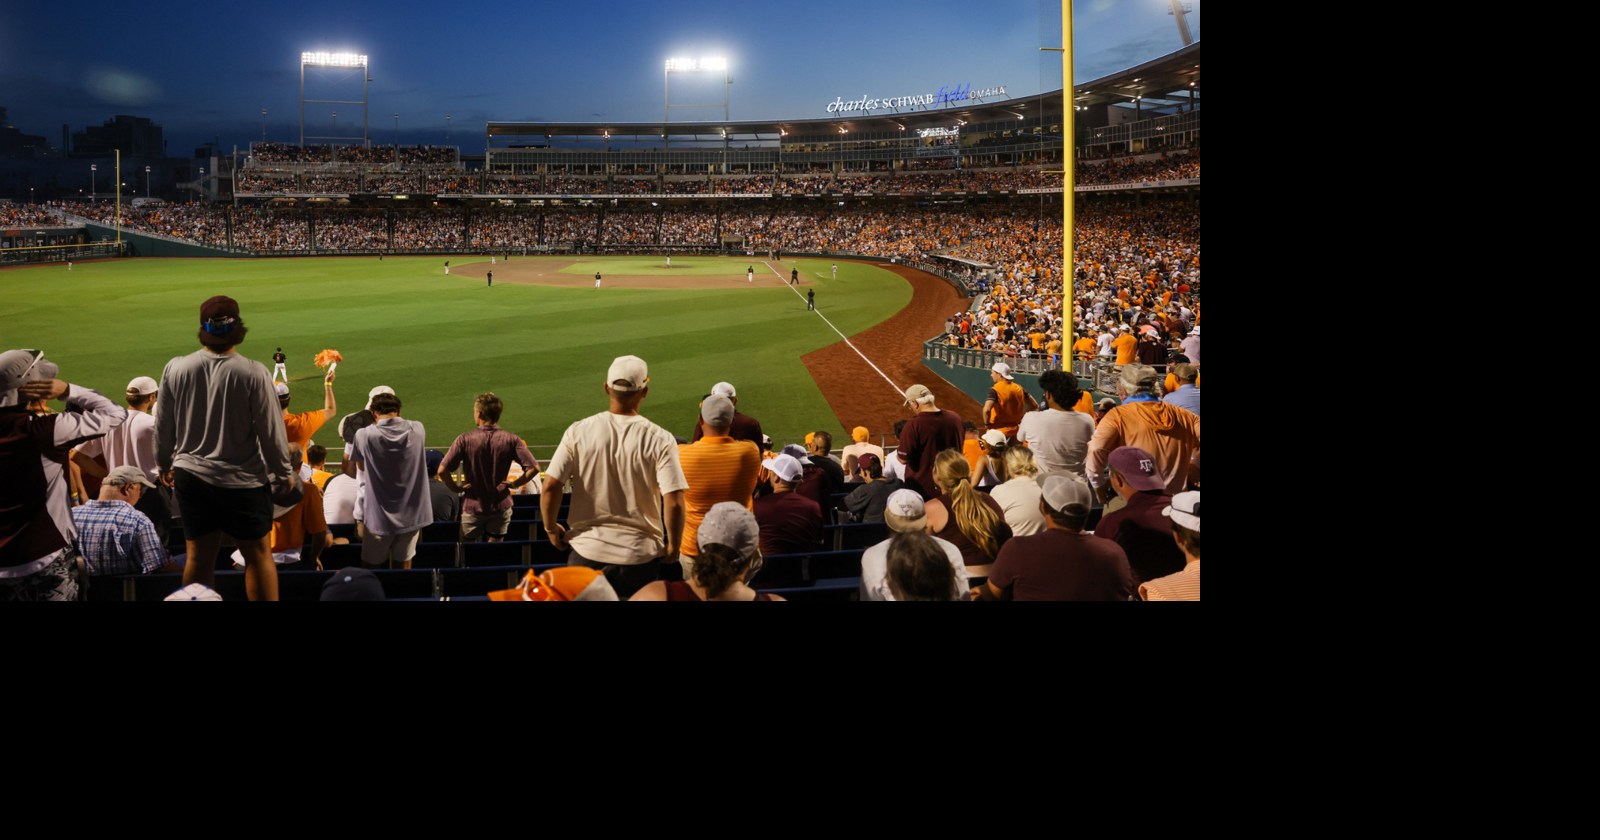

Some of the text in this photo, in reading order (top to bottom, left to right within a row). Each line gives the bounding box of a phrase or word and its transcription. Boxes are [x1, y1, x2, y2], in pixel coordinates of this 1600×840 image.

[826, 82, 1006, 113] charles SCHWAB field OMAHA
